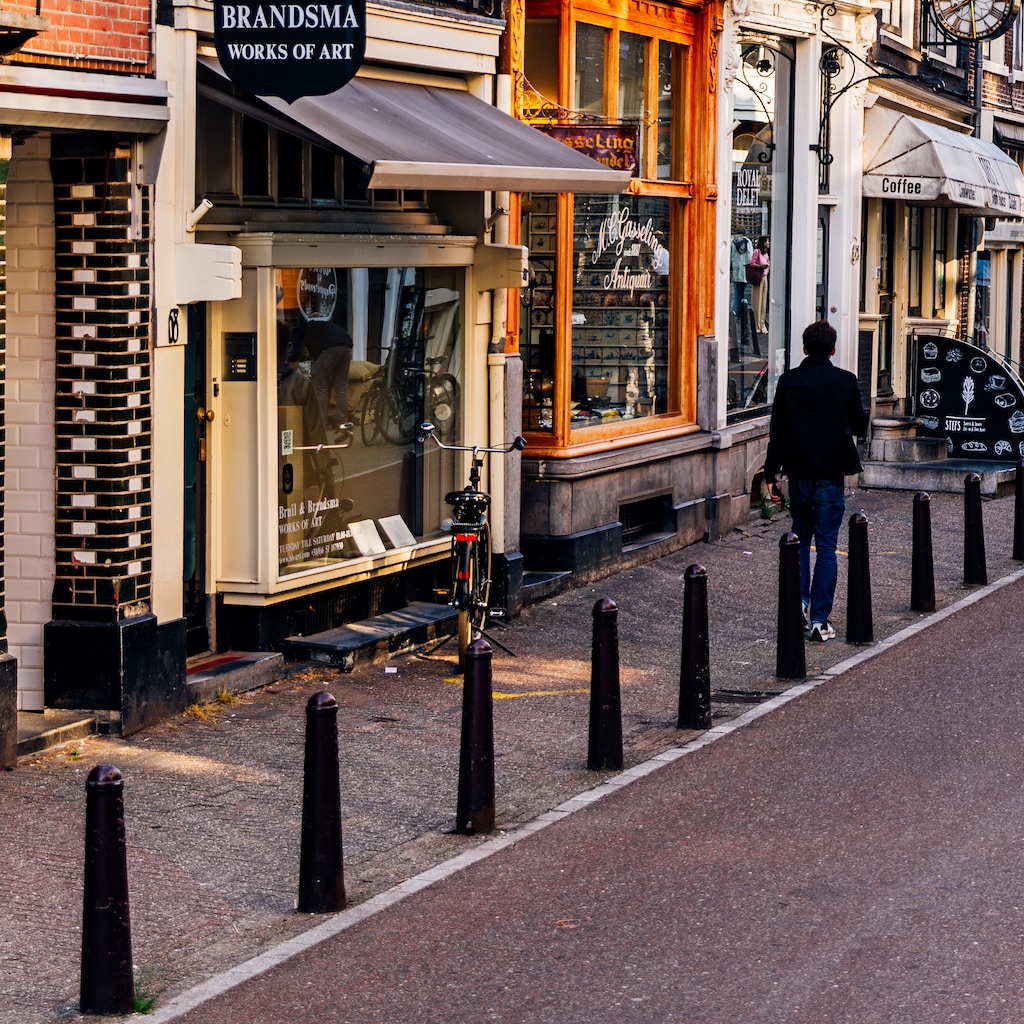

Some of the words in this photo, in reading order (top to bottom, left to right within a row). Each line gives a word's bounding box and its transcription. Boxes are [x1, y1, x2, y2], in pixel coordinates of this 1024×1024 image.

[221, 4, 359, 29] BRANDSMA
[227, 43, 288, 60] WORKS
[292, 43, 316, 60] OF
[319, 43, 354, 60] ART
[737, 169, 760, 187] ROYAL
[882, 177, 922, 194] Coffee
[736, 188, 760, 206] DELFT
[279, 504, 296, 519] Bruil
[299, 501, 305, 515] &
[308, 497, 340, 513] Brandsma
[279, 521, 300, 535] WORKS
[302, 519, 309, 529] OF
[311, 516, 322, 527] ART
[279, 541, 300, 554] TUESDAY
[313, 533, 335, 546] SATURDAY
